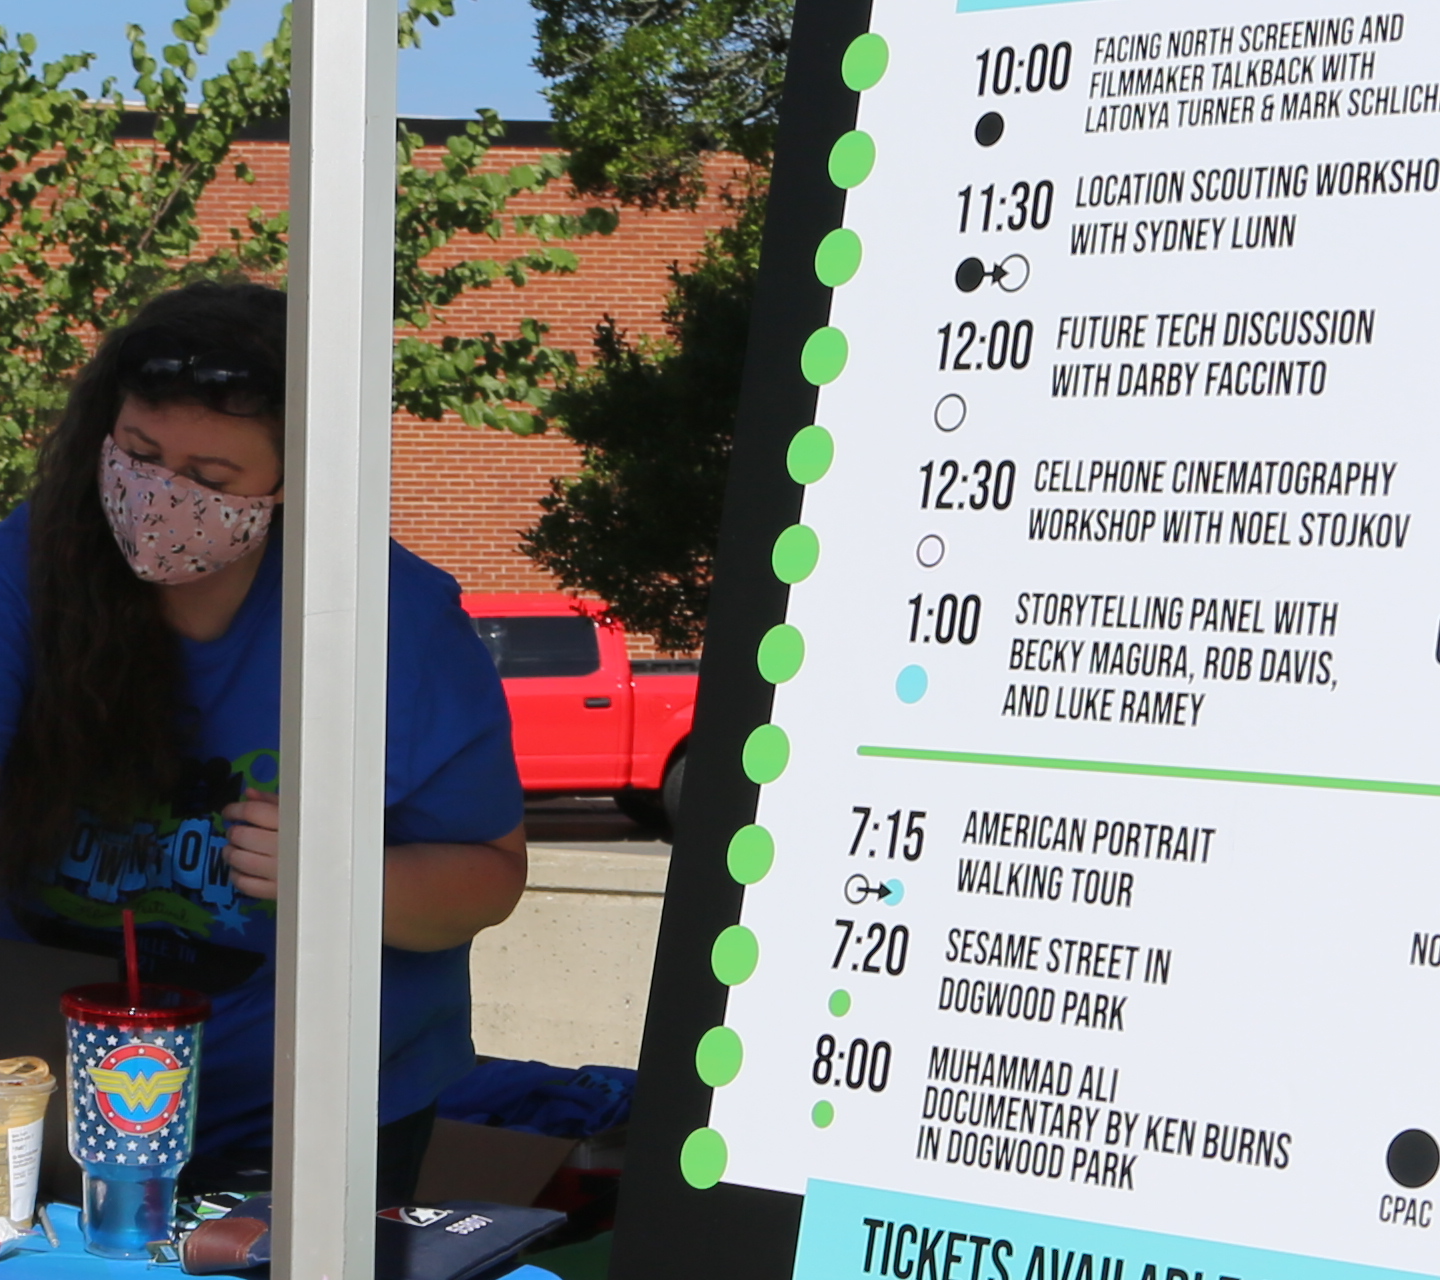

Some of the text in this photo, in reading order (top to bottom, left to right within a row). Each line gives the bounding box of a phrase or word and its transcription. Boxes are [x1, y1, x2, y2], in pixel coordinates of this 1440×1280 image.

[1092, 12, 1405, 64] FACING NORTH SCREENING AND
[974, 39, 1073, 97] 10:00
[1087, 50, 1376, 99] FILMMAKER TALKBACK WITH
[1083, 99, 1170, 134] LATONYA
[1176, 94, 1256, 127] TURNER
[1258, 92, 1275, 123] &
[1278, 88, 1343, 121] MARK
[956, 178, 1055, 234] 11:30
[1074, 169, 1186, 208] LOCATION
[1188, 162, 1310, 203] SCOUTING
[1069, 213, 1297, 256] WITH SYDNEY LUNN
[936, 317, 1035, 372] 12:00
[1055, 308, 1376, 350] FUTURE TECH DISCUSSION
[1050, 359, 1328, 398] WITH DARBY FACCINTO
[918, 458, 1017, 512] 12:30
[1032, 458, 1398, 497] CELLPHONE CINEMATOGRAPHY
[1027, 506, 1411, 549] WORKSHOP WITH NOEL STOJKOV
[906, 591, 983, 647] 1:00
[1013, 590, 1339, 637] STORYTELLING PANEL WITH
[1007, 636, 1337, 688] BECKY MAGURA, ROB DAVIS,
[1000, 682, 1206, 727] AND LUKE RAMEY
[847, 804, 927, 863] 7:15
[961, 809, 1217, 864] AMERICAN PORTRAIT
[955, 857, 1135, 908] WALKING TOUR
[830, 917, 911, 977] 7:20
[943, 926, 1172, 986] SESAME STREET IN
[936, 975, 1128, 1032] DOGWOOD PARK
[810, 1032, 893, 1094] 8:00
[926, 1044, 1119, 1104] MUHAMMAD ALI
[920, 1084, 1293, 1171] DOCUMENTARY BY KEN BURNS
[1377, 1193, 1433, 1229] CPAC
